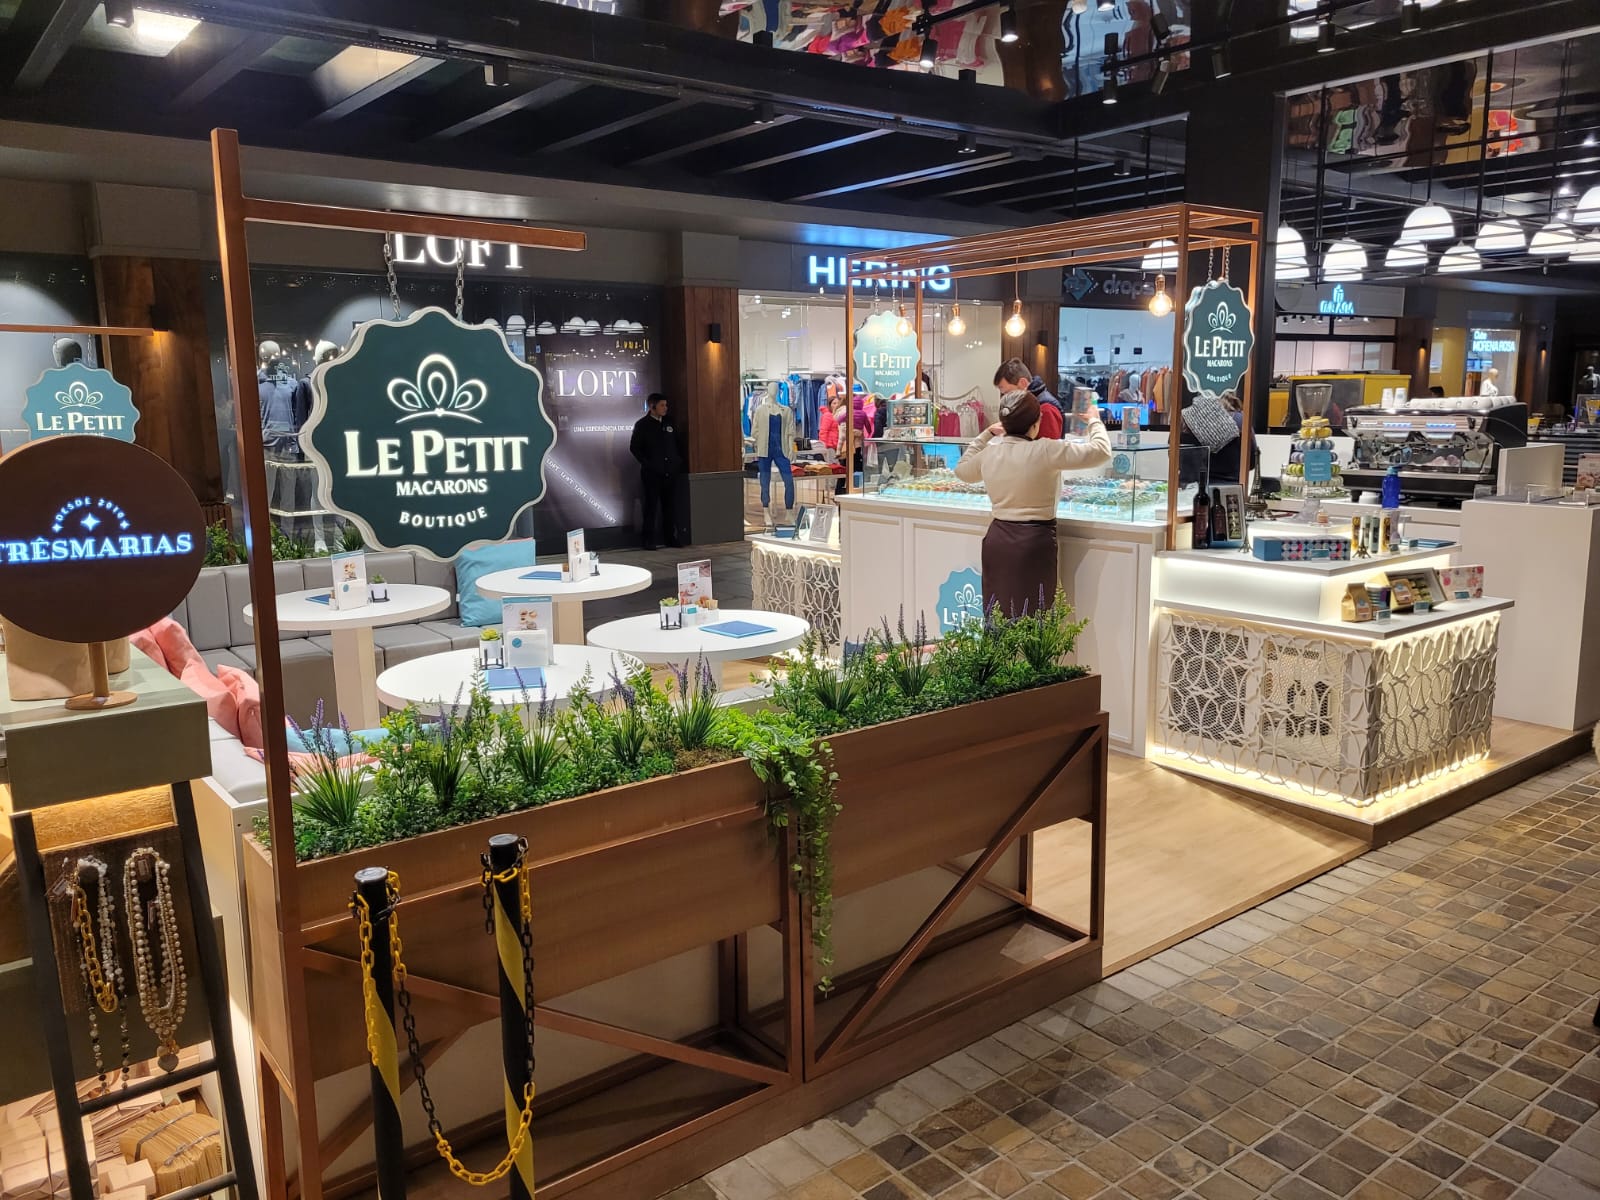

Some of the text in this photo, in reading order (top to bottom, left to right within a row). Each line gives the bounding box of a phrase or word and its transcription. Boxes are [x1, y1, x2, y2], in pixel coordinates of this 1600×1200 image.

[1194, 335, 1247, 357] LE PETIT
[862, 351, 913, 369] LE PETIT
[555, 369, 638, 398] LOFT
[36, 411, 125, 431] LE PETIT
[344, 429, 529, 477] LE PETIT
[395, 478, 489, 497] MACARONS
[55, 496, 92, 522] DESDE
[399, 506, 489, 529] BOUTIQUE
